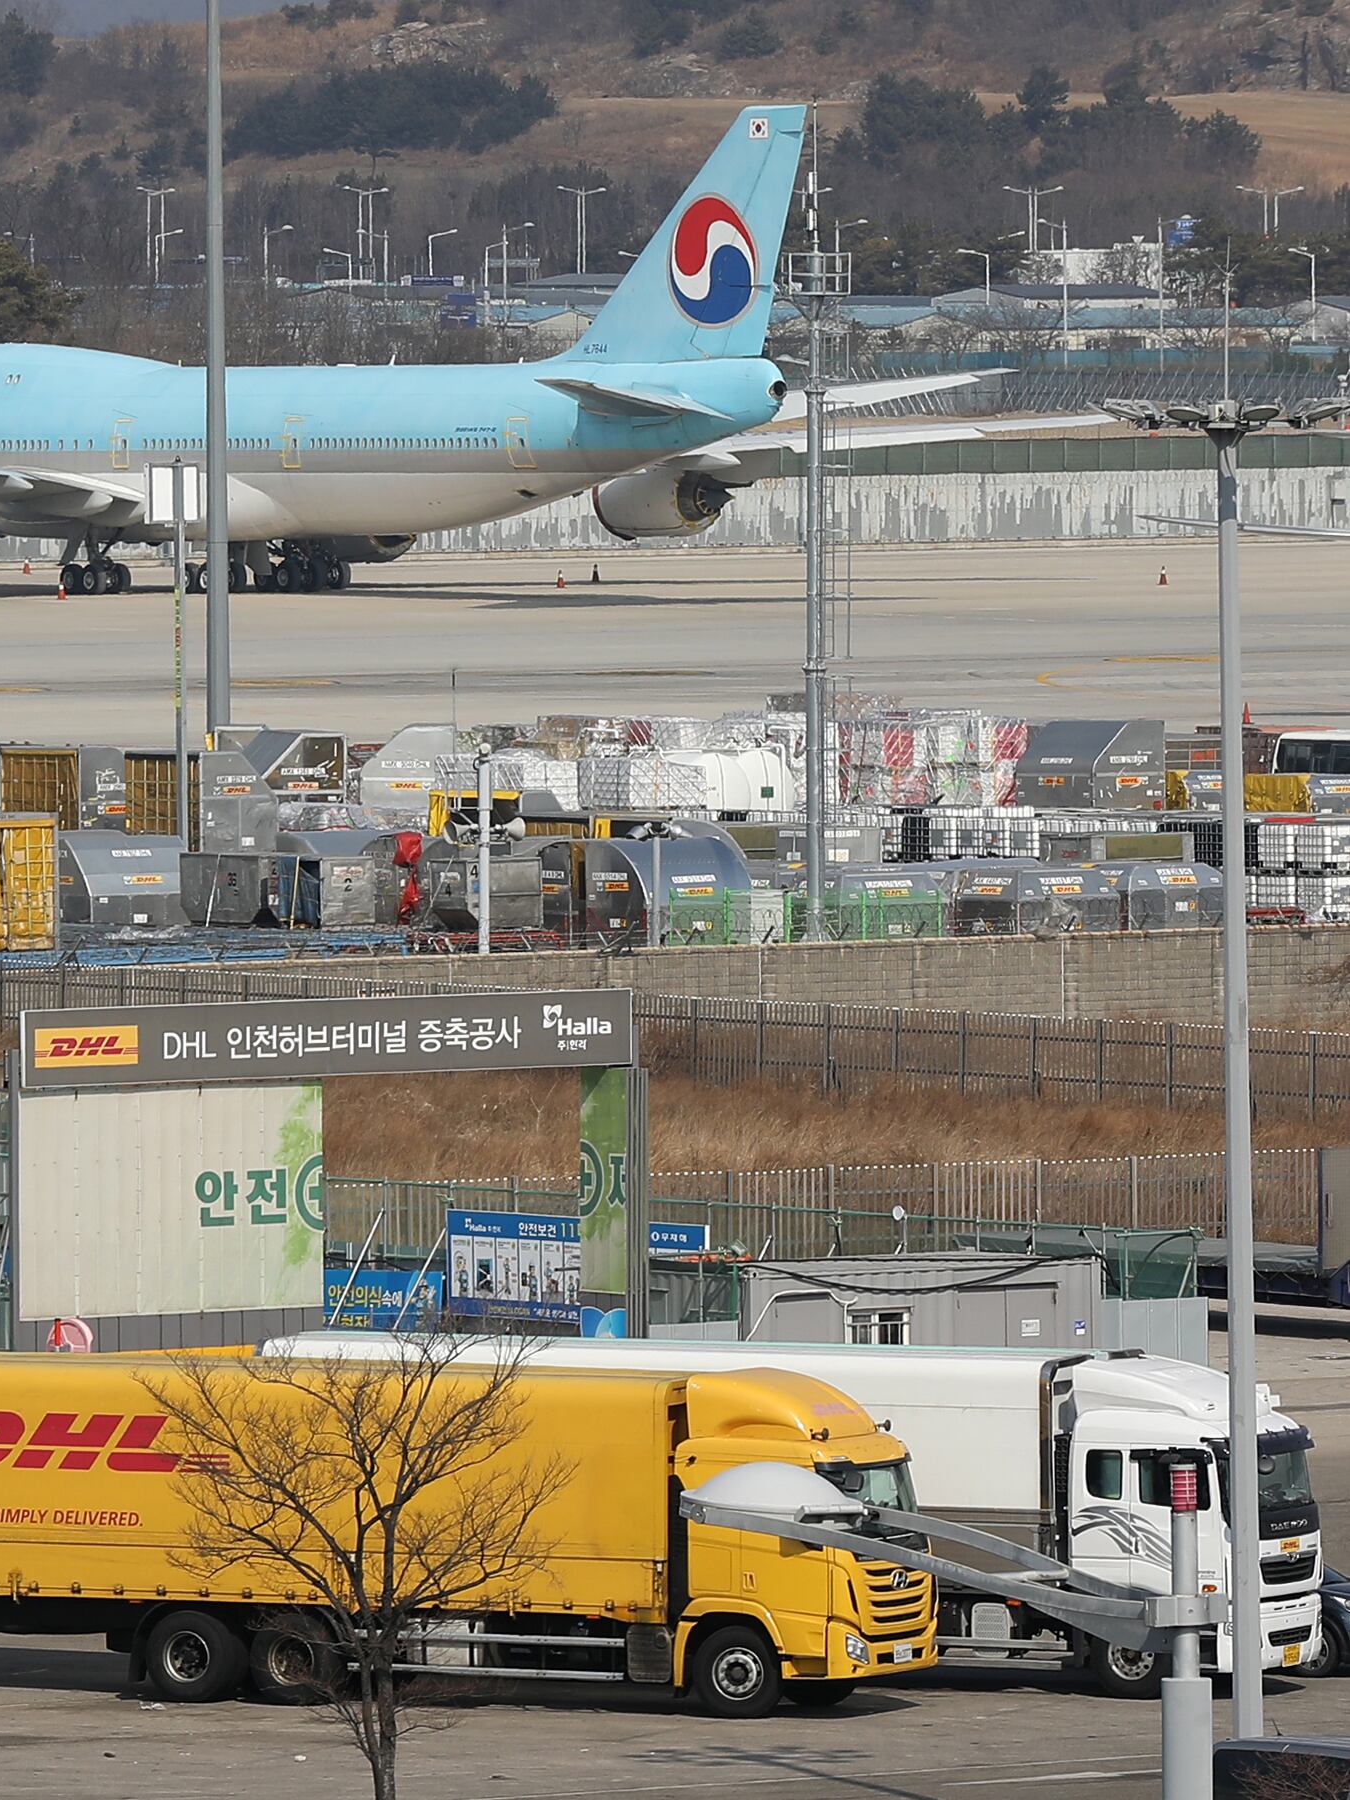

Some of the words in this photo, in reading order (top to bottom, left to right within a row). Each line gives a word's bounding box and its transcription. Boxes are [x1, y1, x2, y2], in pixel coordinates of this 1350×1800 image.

[470, 864, 479, 879] 4
[557, 1017, 612, 1036] Halla
[47, 1036, 124, 1058] DHL
[163, 1031, 217, 1060] DHL
[226, 1019, 407, 1060] 인천허브터미널
[417, 1015, 522, 1053] 증축공사
[195, 1168, 288, 1228] 안전
[518, 1222, 557, 1238] 안전보건
[561, 1223, 582, 1239] 11
[53, 1509, 144, 1528] DELIVERED.
